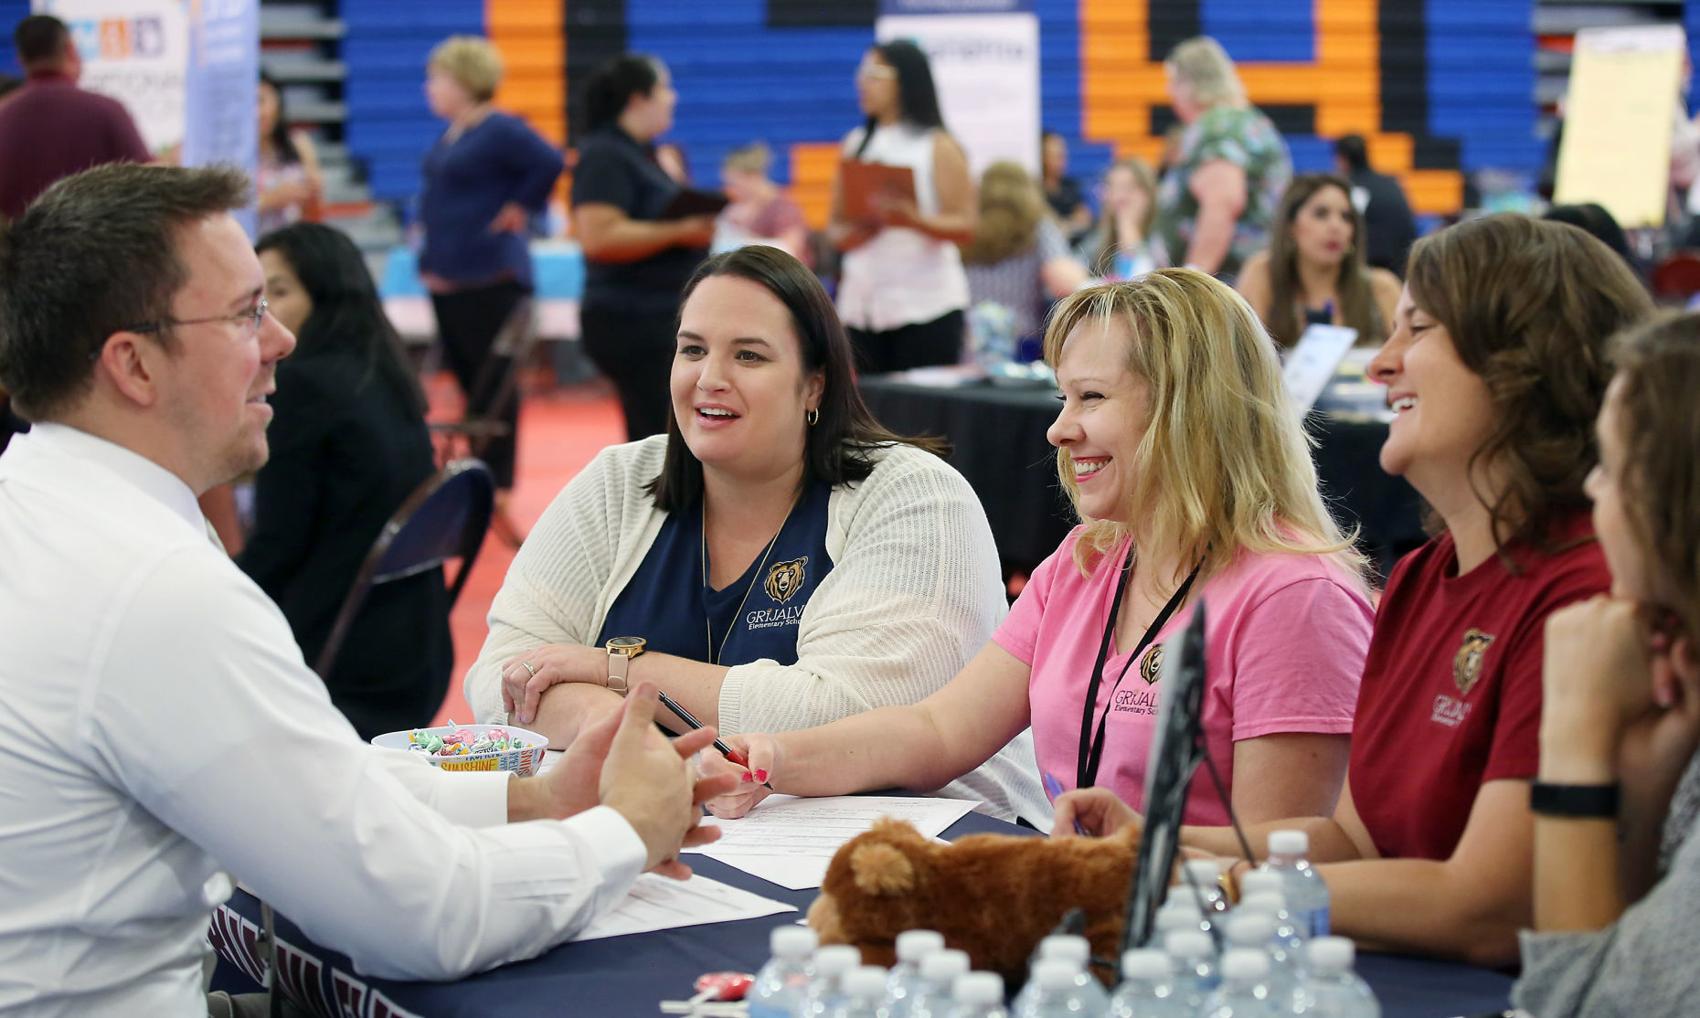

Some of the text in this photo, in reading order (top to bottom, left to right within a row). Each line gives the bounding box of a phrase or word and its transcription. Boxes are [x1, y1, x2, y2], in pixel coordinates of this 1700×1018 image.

[746, 604, 805, 624] GRIJALV
[748, 618, 800, 630] Elementary Scho
[1115, 690, 1158, 707] GRIJAL
